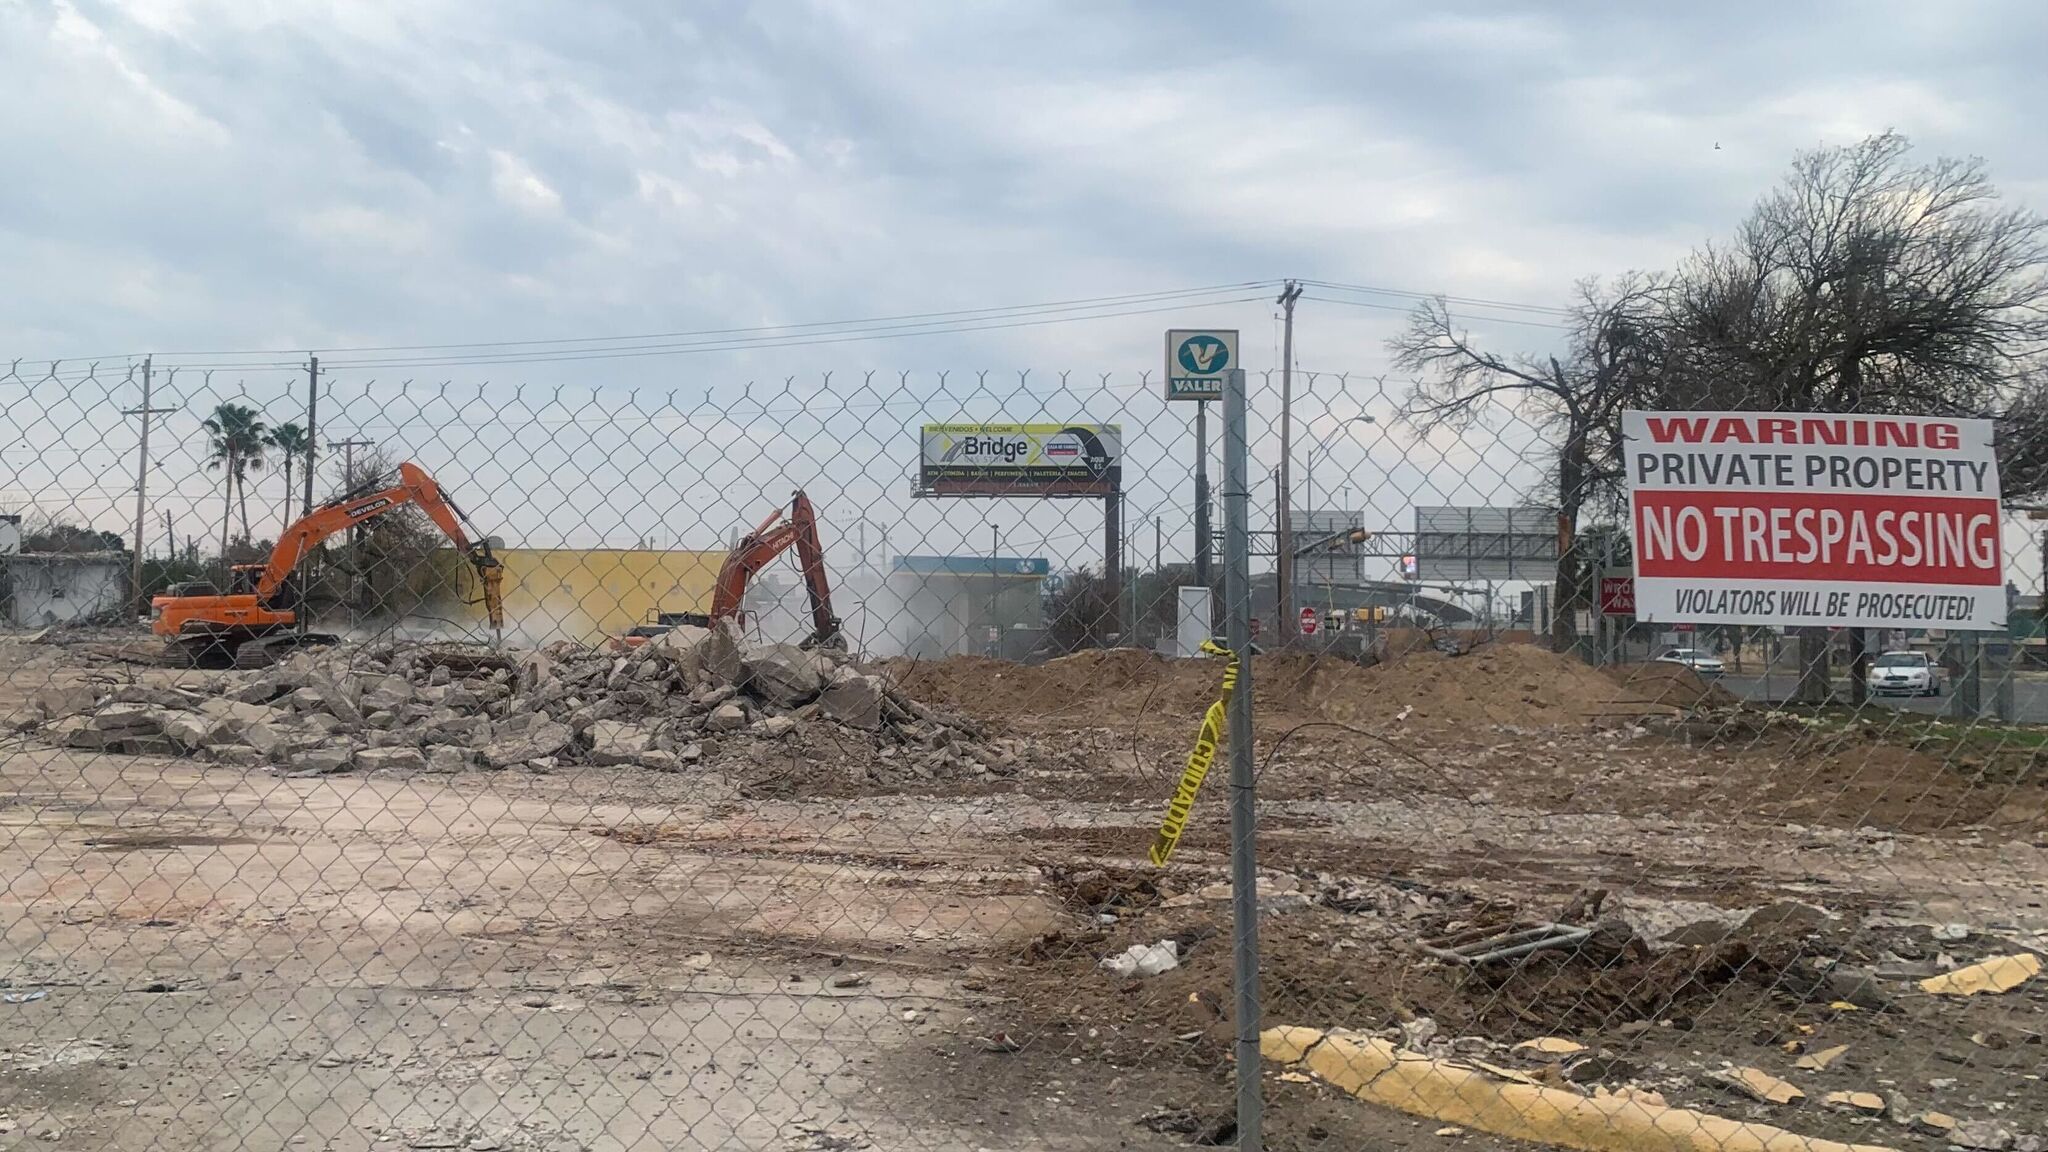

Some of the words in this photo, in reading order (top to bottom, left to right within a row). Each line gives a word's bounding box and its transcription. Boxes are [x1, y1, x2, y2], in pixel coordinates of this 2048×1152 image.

[1174, 380, 1222, 392] VALER
[1645, 418, 1960, 449] WARNING
[965, 436, 1028, 463] Bridge
[1637, 453, 1795, 486] PRIVATE
[1805, 455, 1988, 492] PROPERTY
[350, 500, 386, 518] DEVELON
[772, 531, 795, 549] HITACHI
[1642, 505, 1708, 561] NO
[1713, 507, 1995, 569] TRESPASSING
[1604, 583, 1635, 594] WRO
[1613, 598, 1634, 608] WA
[1675, 589, 1775, 615] VIOLATORS
[1780, 591, 1821, 616] WILL
[1825, 592, 1850, 617] BE
[1856, 593, 1975, 621] PROSECUTED!
[1160, 739, 1212, 839] CUIDADO
